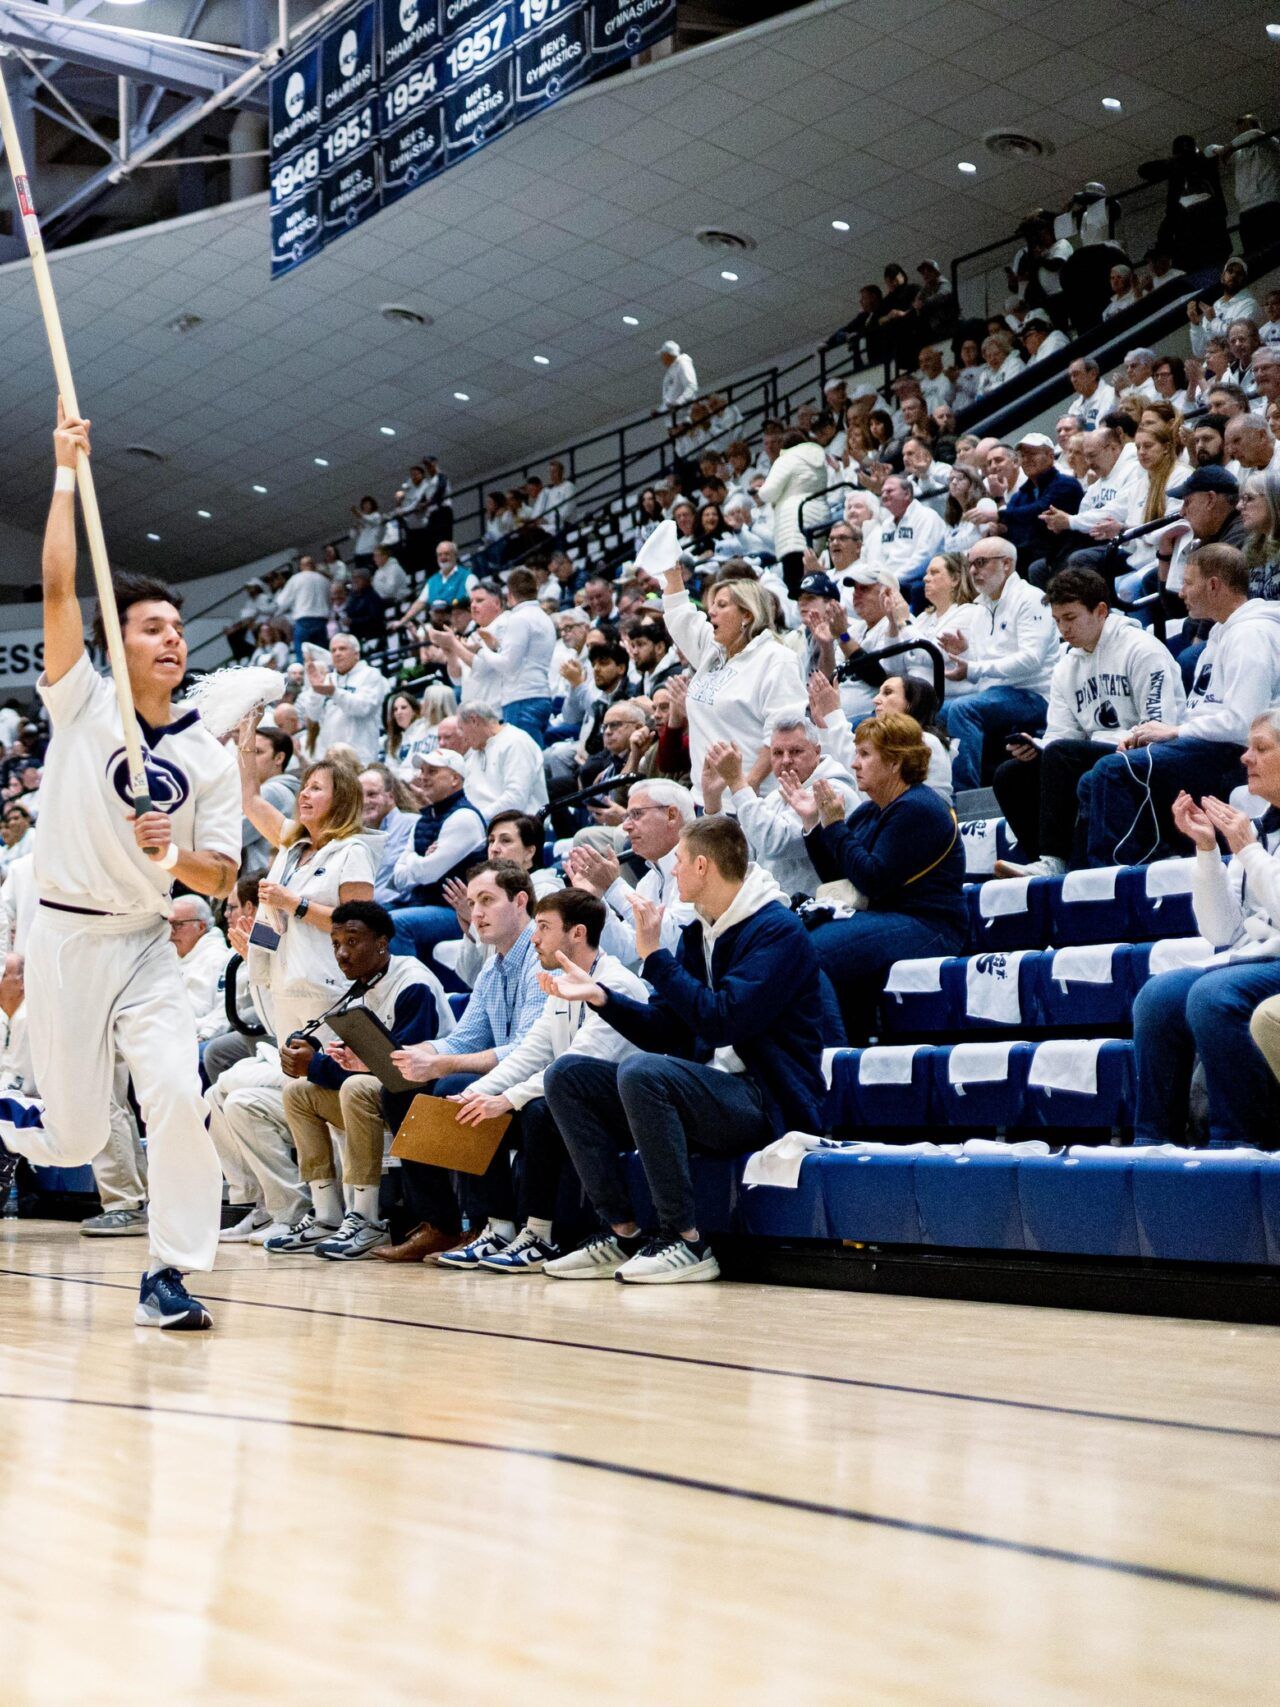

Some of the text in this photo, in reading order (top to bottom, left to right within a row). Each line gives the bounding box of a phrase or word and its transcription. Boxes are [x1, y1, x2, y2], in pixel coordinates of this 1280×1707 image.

[520, 0, 561, 29] 19
[604, 0, 664, 36] GYMNASTIC
[385, 17, 437, 65] CHAMPIONS
[446, 12, 508, 79] 1957
[526, 41, 582, 85] GYMNASTICS
[540, 33, 568, 61] MEN'S
[385, 62, 438, 121] 1954
[323, 107, 372, 162] 1953
[272, 148, 319, 200] 1948
[1099, 673, 1131, 697] TATE
